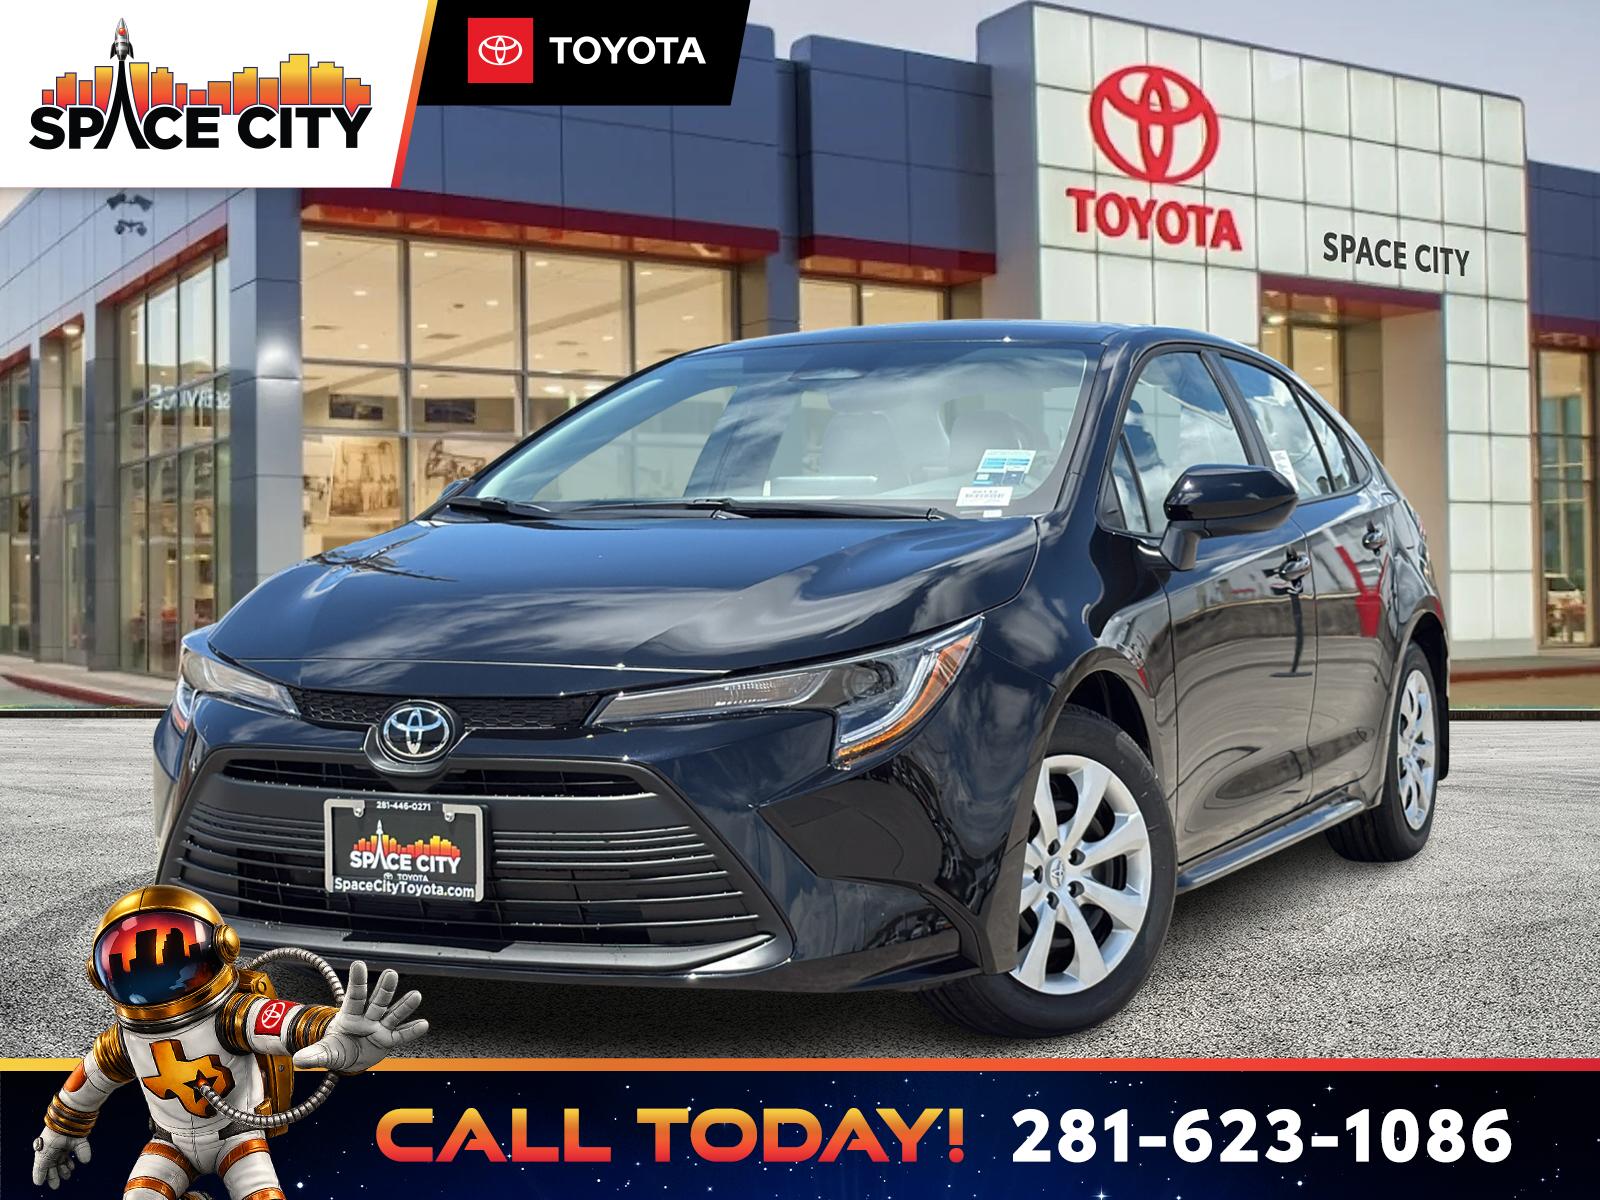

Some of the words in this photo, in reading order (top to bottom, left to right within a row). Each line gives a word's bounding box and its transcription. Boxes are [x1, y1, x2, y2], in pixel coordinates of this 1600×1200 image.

[1066, 188, 1242, 251] TOYOTA
[1323, 231, 1407, 270] SPACE
[1414, 244, 1471, 277] CITY
[376, 801, 432, 811] 281-446-0271
[350, 850, 412, 872] SPACE
[416, 855, 461, 874] CITY
[334, 877, 475, 898] SpaceCityToyota.com
[397, 873, 429, 883] TOYOTA
